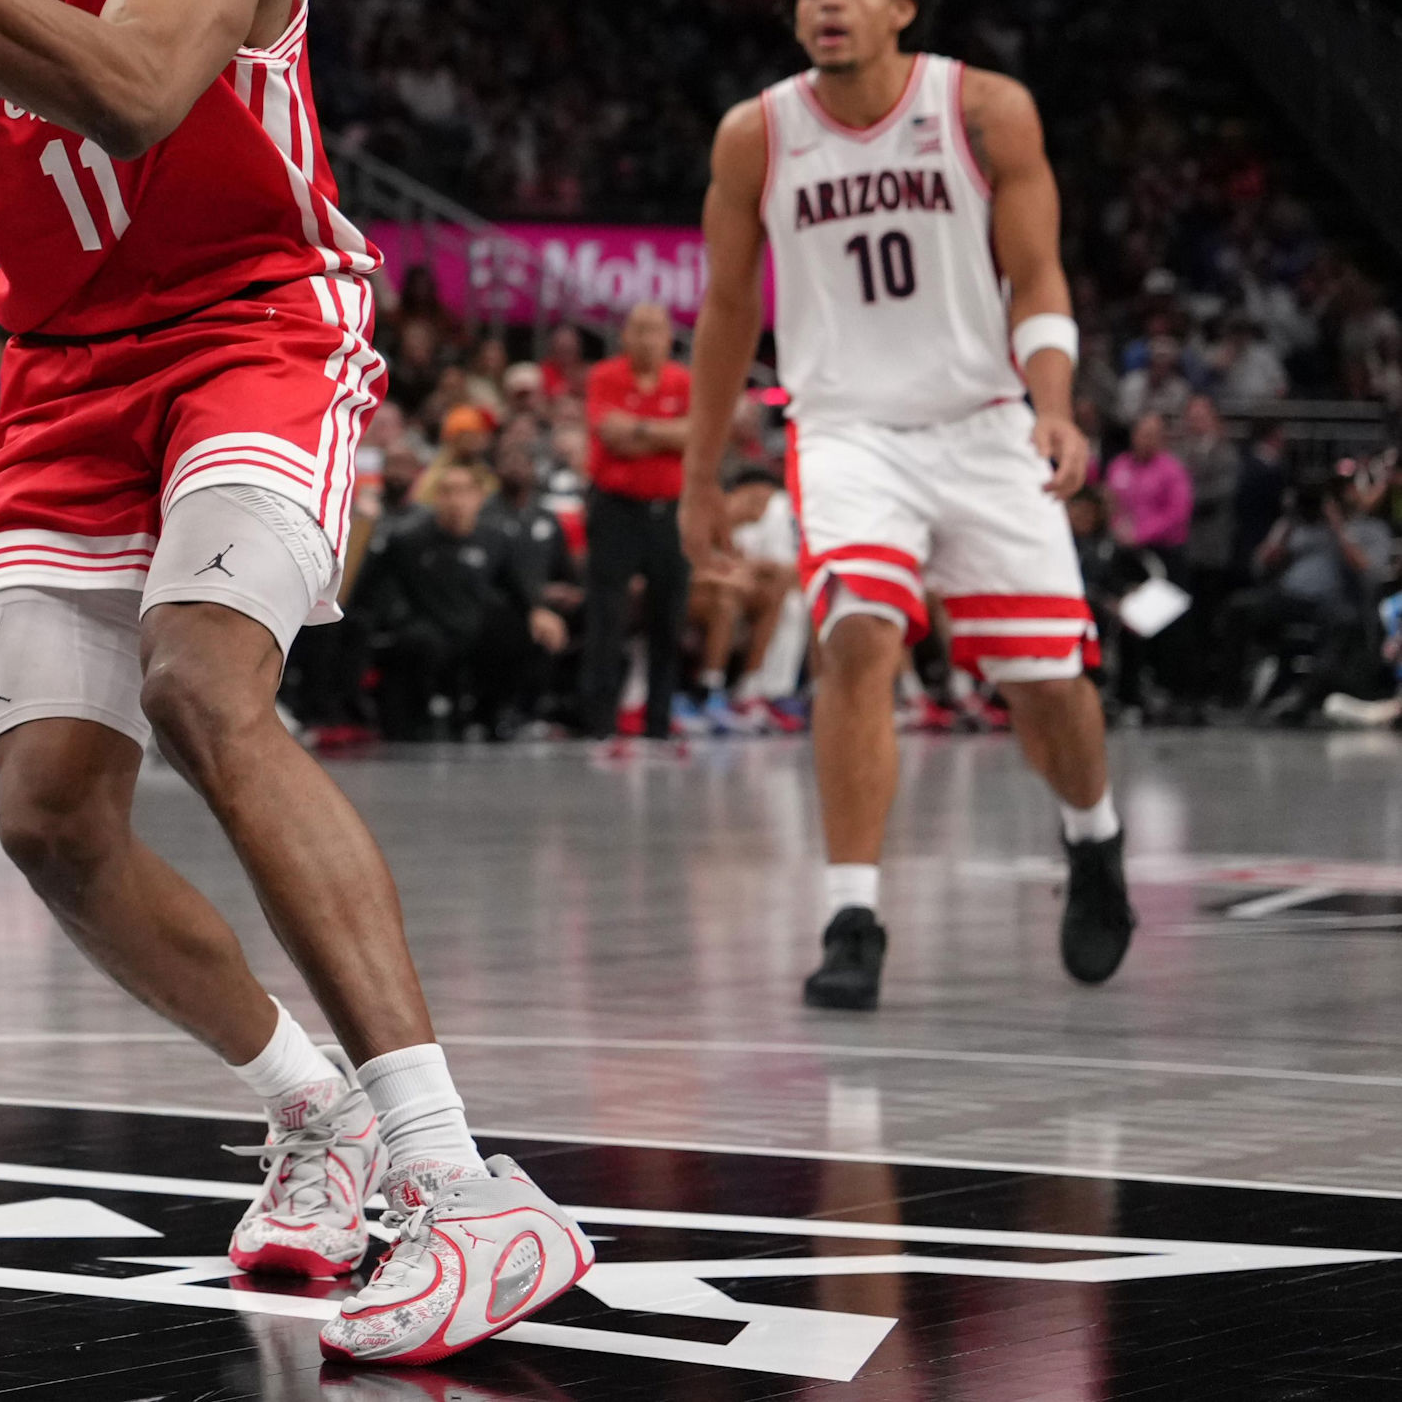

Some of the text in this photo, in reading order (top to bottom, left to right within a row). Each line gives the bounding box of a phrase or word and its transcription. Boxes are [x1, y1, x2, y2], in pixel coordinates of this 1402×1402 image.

[39, 136, 131, 252] 11
[795, 169, 956, 232] ARIZONA
[845, 231, 916, 306] 10
